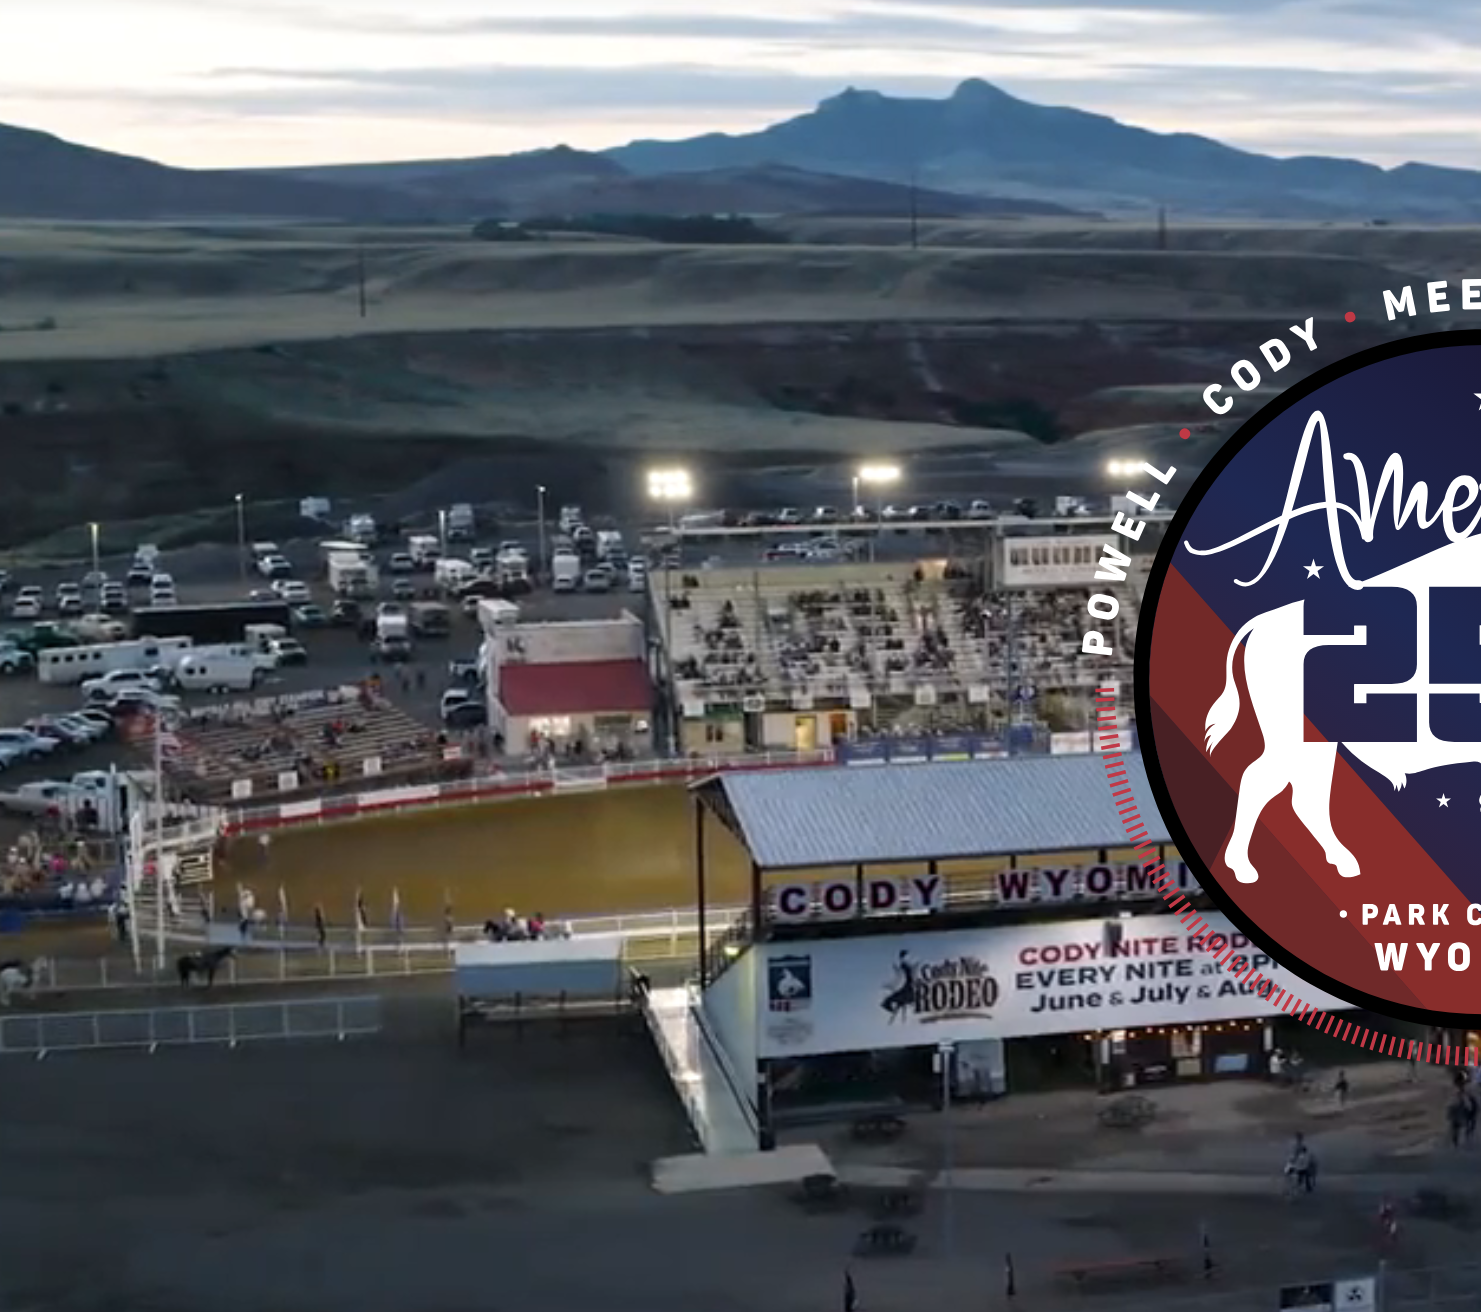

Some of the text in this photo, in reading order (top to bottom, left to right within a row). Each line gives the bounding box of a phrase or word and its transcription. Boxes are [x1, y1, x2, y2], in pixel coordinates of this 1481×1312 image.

[779, 876, 940, 915] CODY
[1019, 932, 1262, 966] CODY NITE ROD
[1016, 953, 1279, 989] EVERY NITE at 8P
[915, 977, 999, 1013] RODEO
[1030, 978, 1281, 1013] June & July & Aug.
